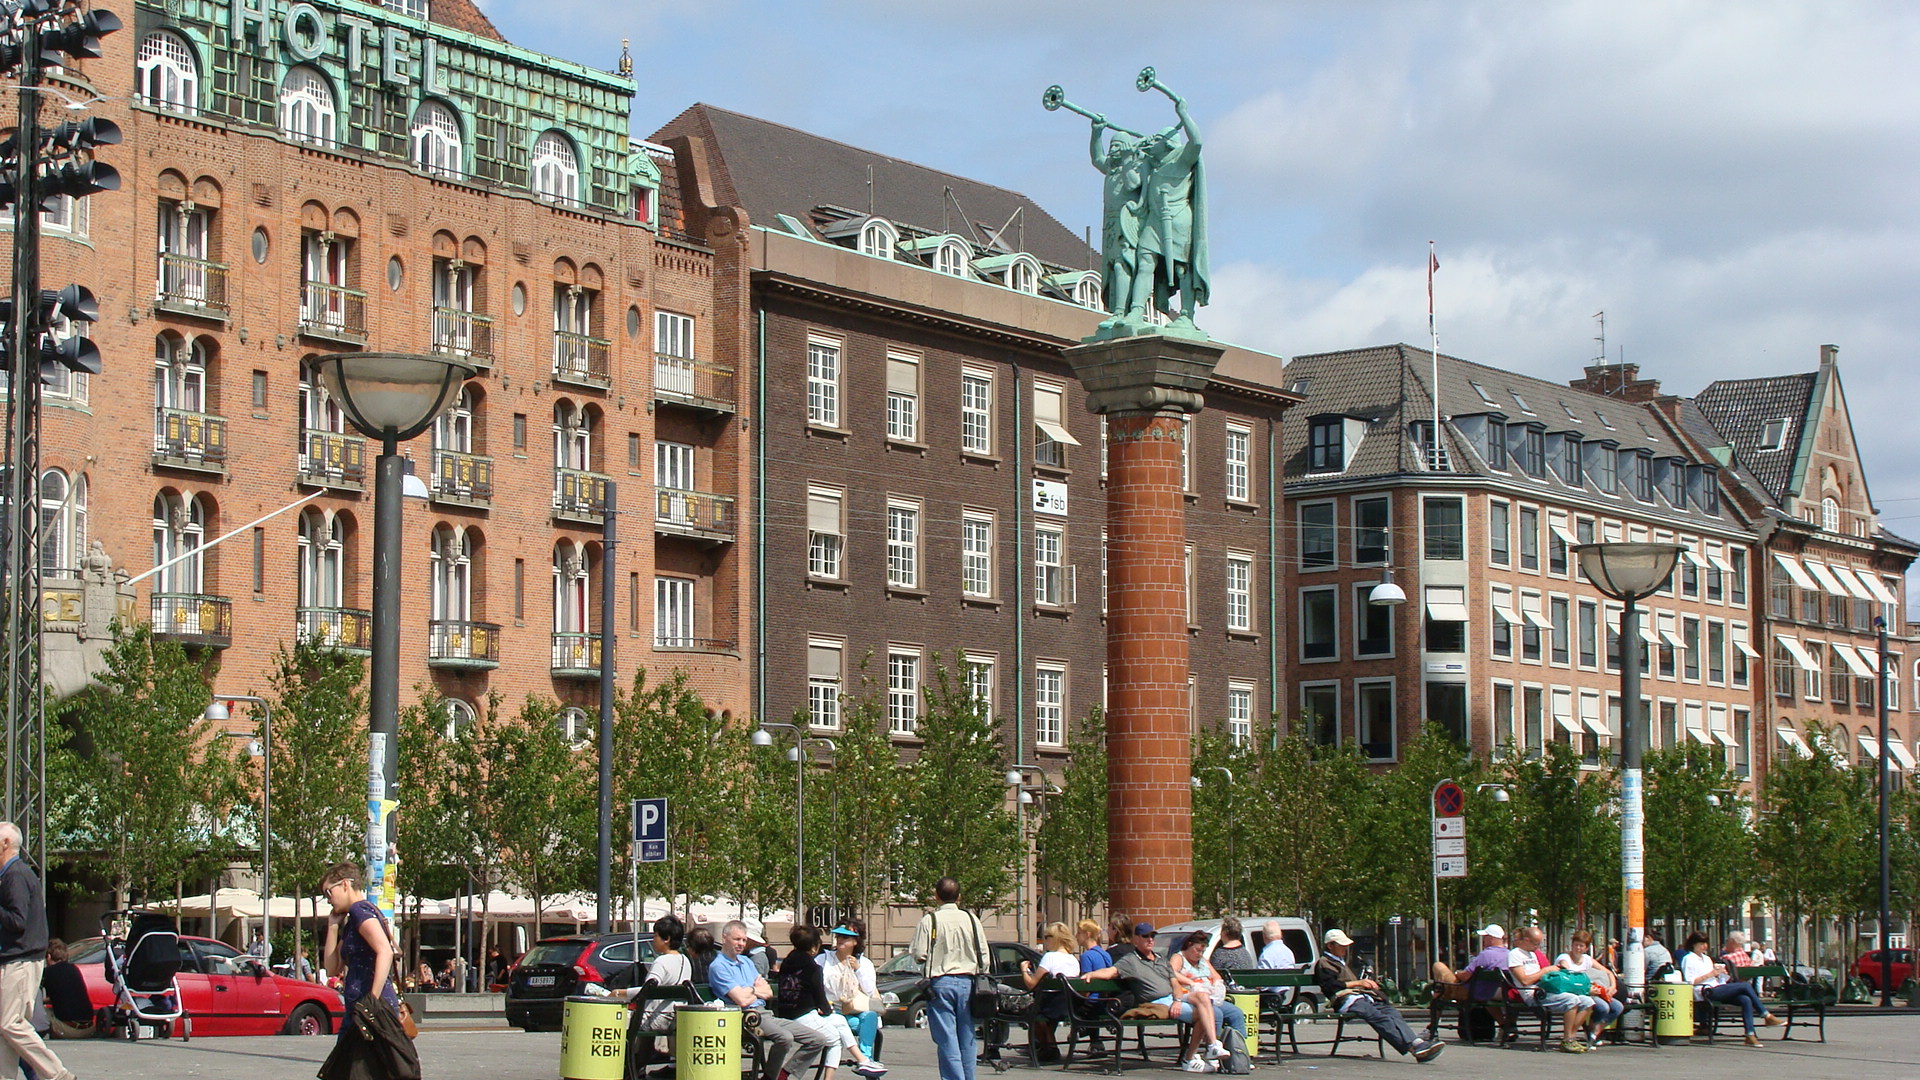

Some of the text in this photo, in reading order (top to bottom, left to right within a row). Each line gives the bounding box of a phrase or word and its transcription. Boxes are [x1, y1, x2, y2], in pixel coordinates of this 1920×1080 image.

[230, 0, 450, 98] HOTEL
[1050, 494, 1066, 511] fsb
[641, 804, 659, 836] P
[592, 1027, 622, 1040] REN
[693, 1035, 726, 1048] REN
[591, 1044, 621, 1057] KBH
[693, 1053, 726, 1065] KBH
